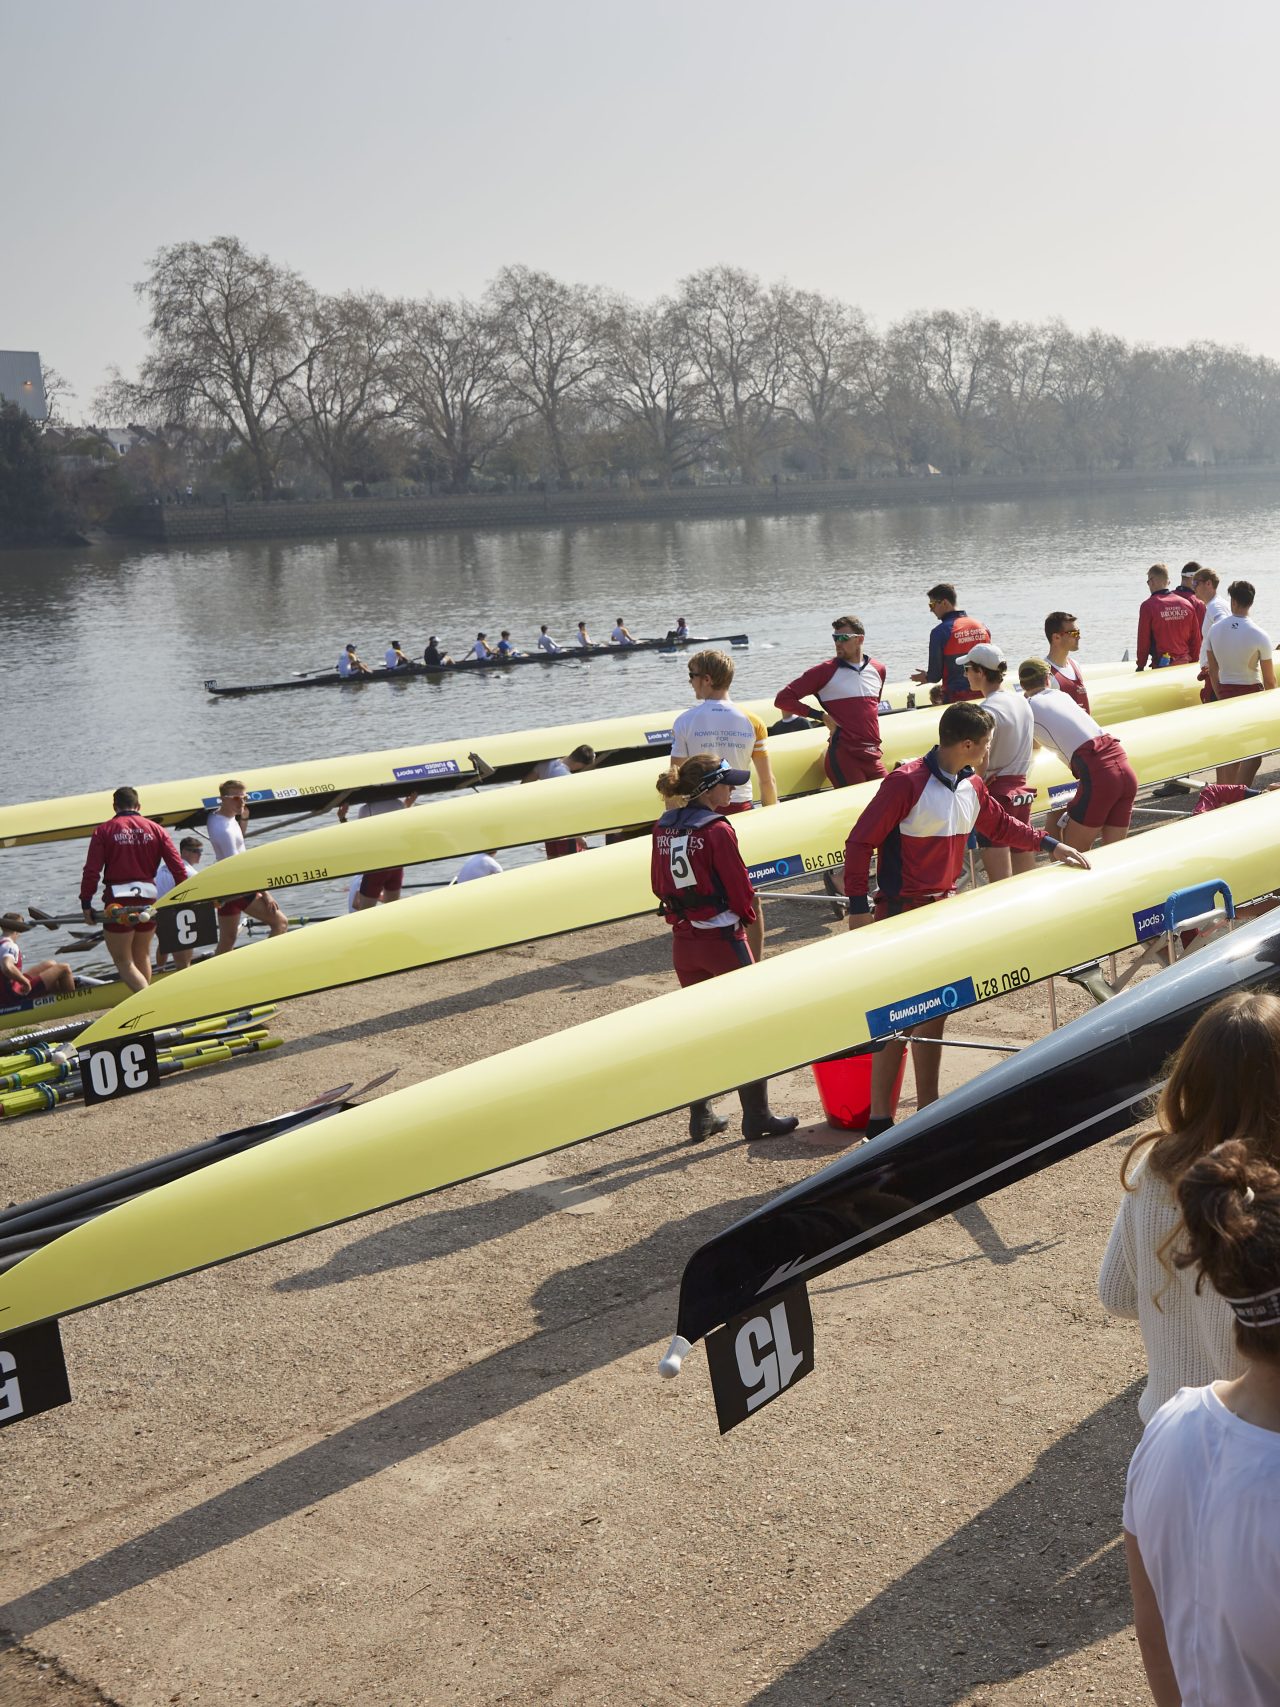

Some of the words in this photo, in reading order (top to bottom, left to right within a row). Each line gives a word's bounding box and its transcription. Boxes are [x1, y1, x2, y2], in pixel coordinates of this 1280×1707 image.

[1160, 610, 1188, 618] BROOKES
[720, 730, 752, 738] TOGETHER
[396, 770, 414, 779] sport
[275, 788, 298, 799] GBR
[672, 846, 689, 879] 5
[805, 855, 825, 871] 319
[267, 873, 299, 888] LOWE
[303, 868, 328, 881] PETE
[757, 867, 776, 879] world
[176, 909, 198, 945] 3
[1138, 913, 1161, 932] sport
[1002, 966, 1031, 991] OBU
[976, 977, 1000, 1000] 821
[34, 996, 55, 1007] GBR
[919, 996, 942, 1015] world
[889, 1004, 920, 1023] rowing
[10, 1025, 67, 1043] NOTTINGHAM
[90, 1043, 149, 1096] 30
[734, 1301, 804, 1413] 15
